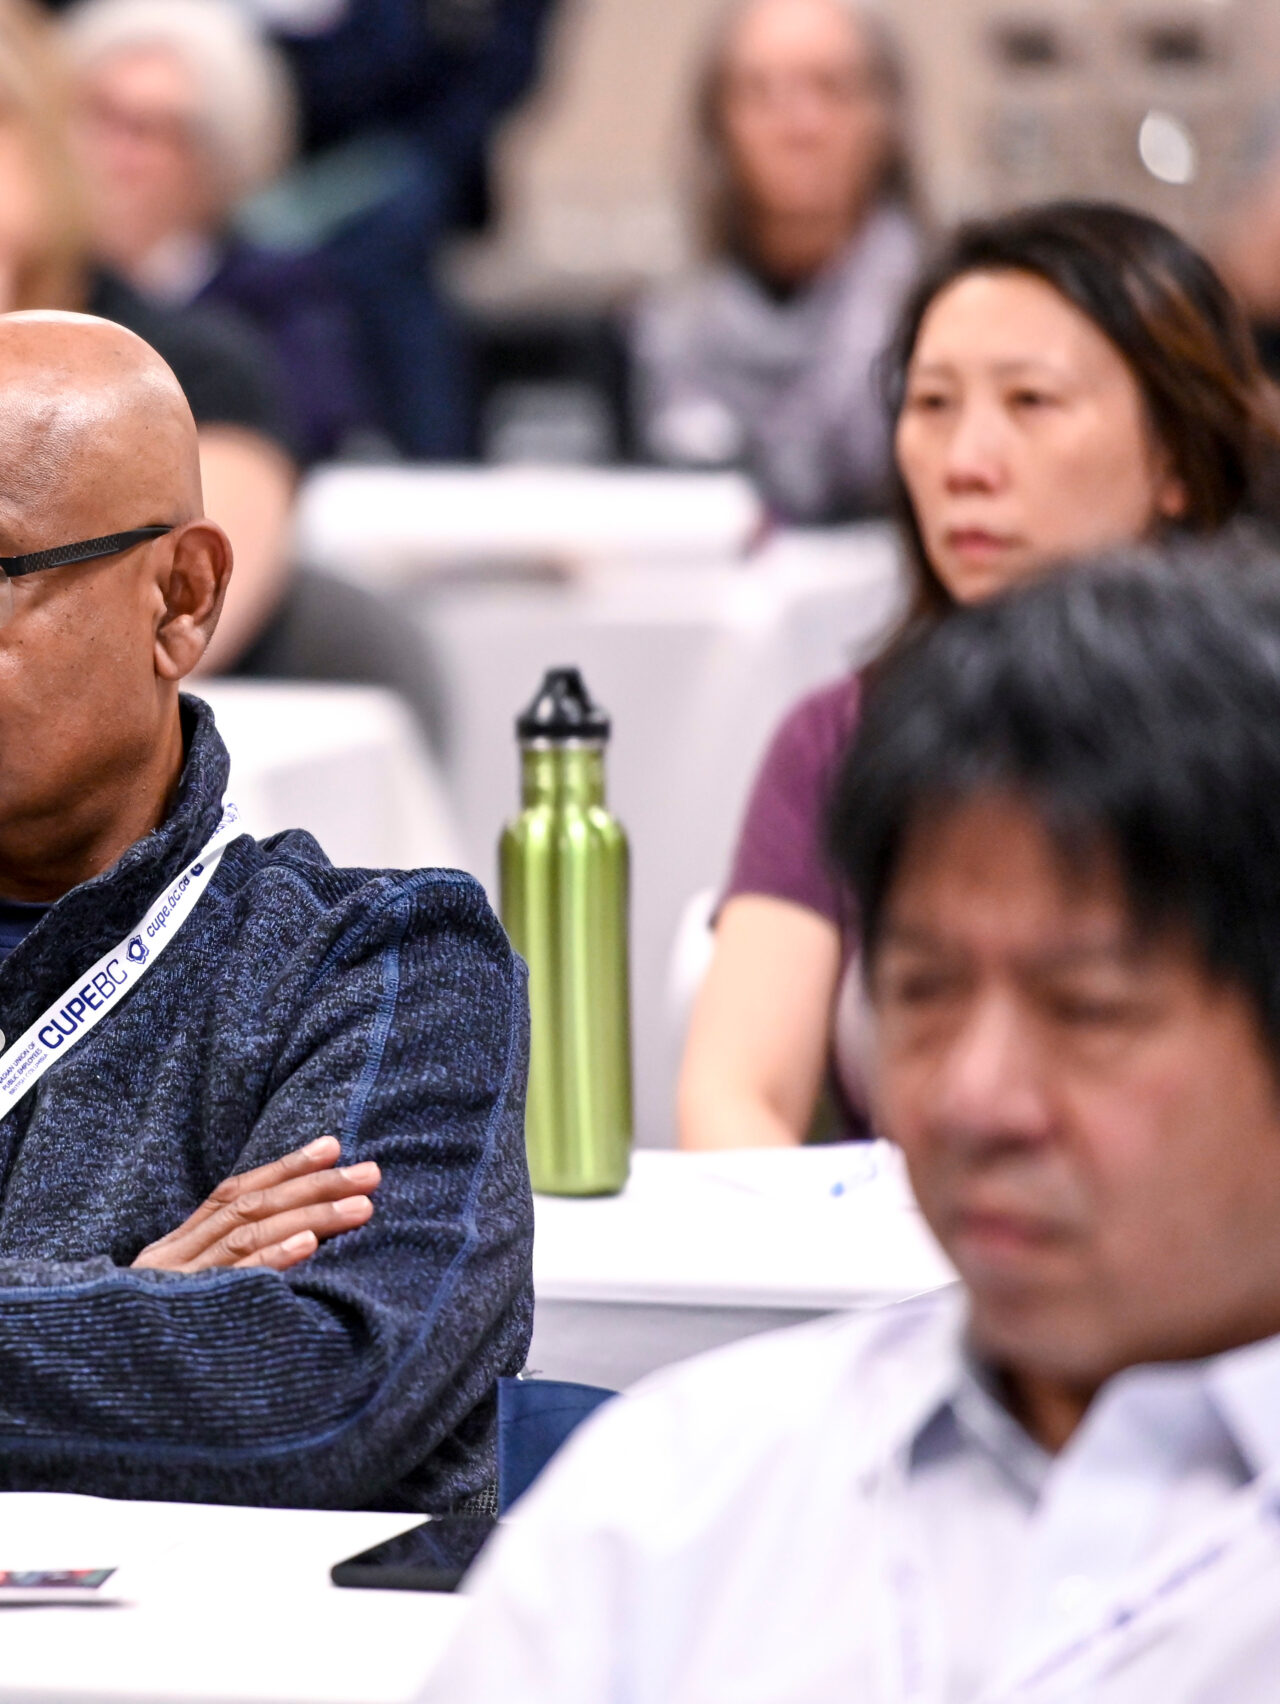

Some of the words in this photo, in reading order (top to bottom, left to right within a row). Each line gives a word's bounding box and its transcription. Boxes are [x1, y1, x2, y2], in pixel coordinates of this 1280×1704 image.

[146, 874, 191, 937] cupe.bc.ca
[38, 958, 128, 1049] CUPEBC
[2, 1073, 18, 1091] PUBLIC
[17, 1047, 43, 1075] EMPLOYEES
[13, 1048, 30, 1067] UNION
[28, 1041, 36, 1051] OF
